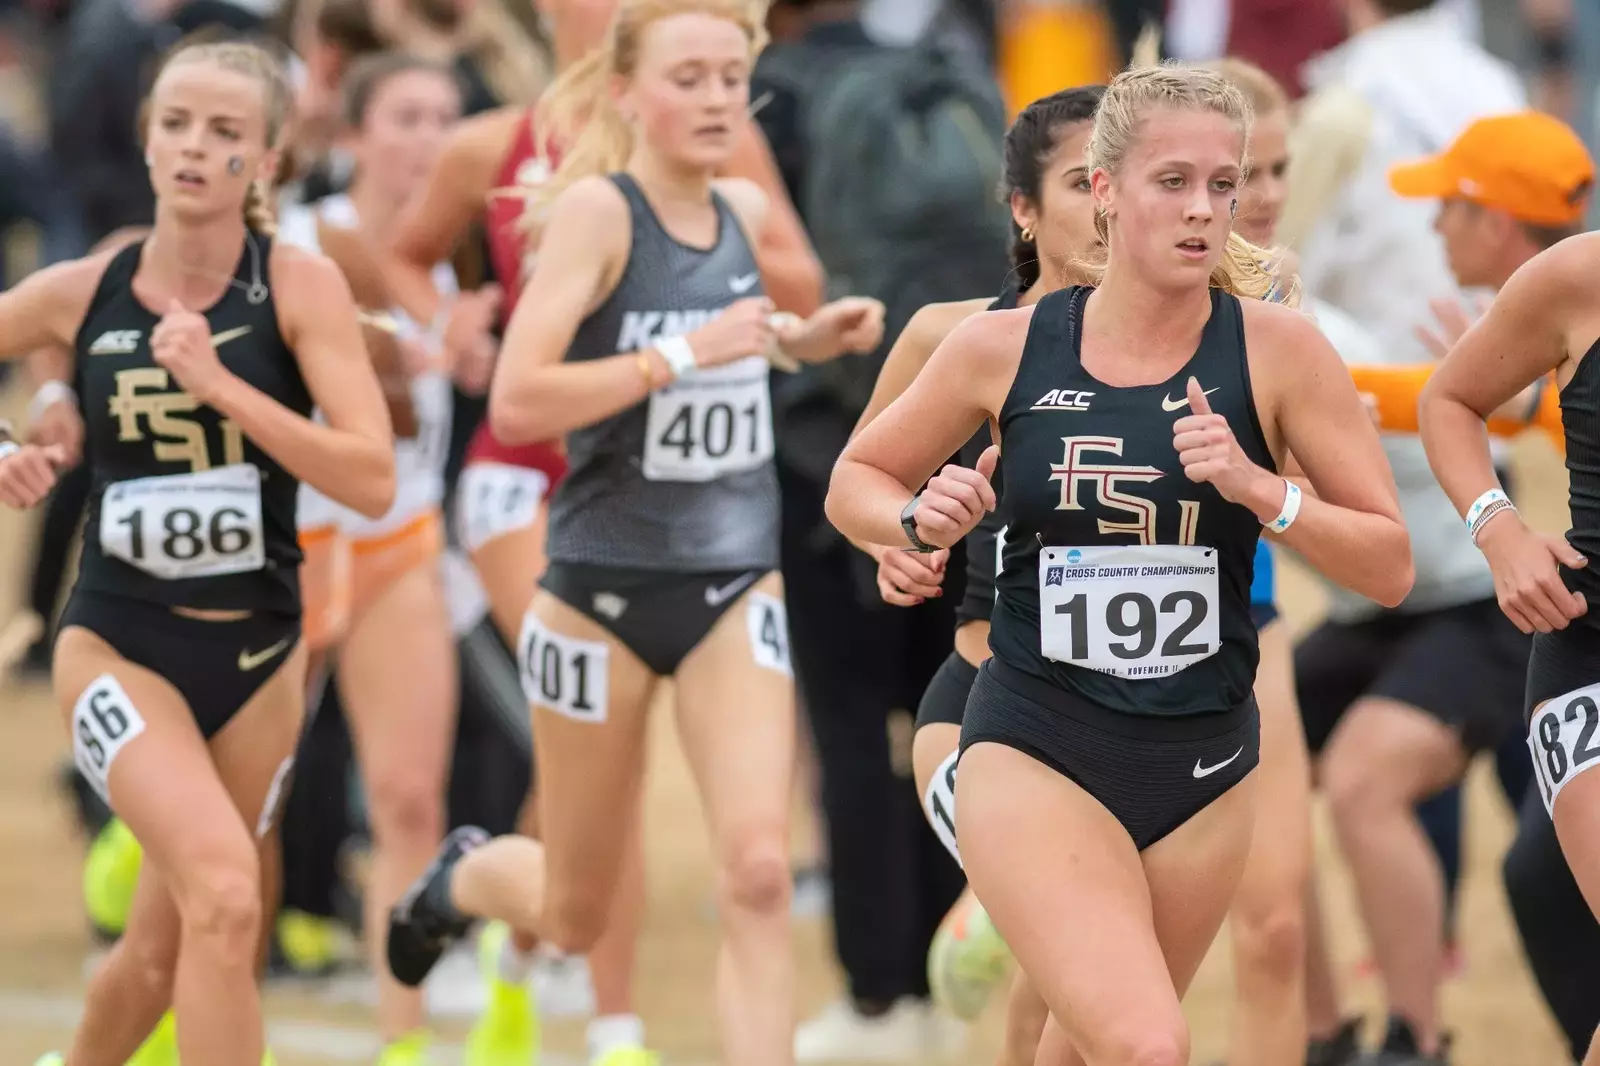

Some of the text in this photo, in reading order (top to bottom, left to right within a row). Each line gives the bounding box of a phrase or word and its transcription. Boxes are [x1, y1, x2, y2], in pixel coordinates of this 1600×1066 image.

[1034, 388, 1097, 407] ACC
[659, 401, 758, 459] 401
[117, 507, 252, 560] 186
[1065, 565, 1216, 578] CROSS COUNTRY CHAMPIONSHIPS
[1054, 590, 1210, 660] 192
[1128, 665, 1169, 675] NOVEMBER
[1533, 696, 1600, 806] 182
